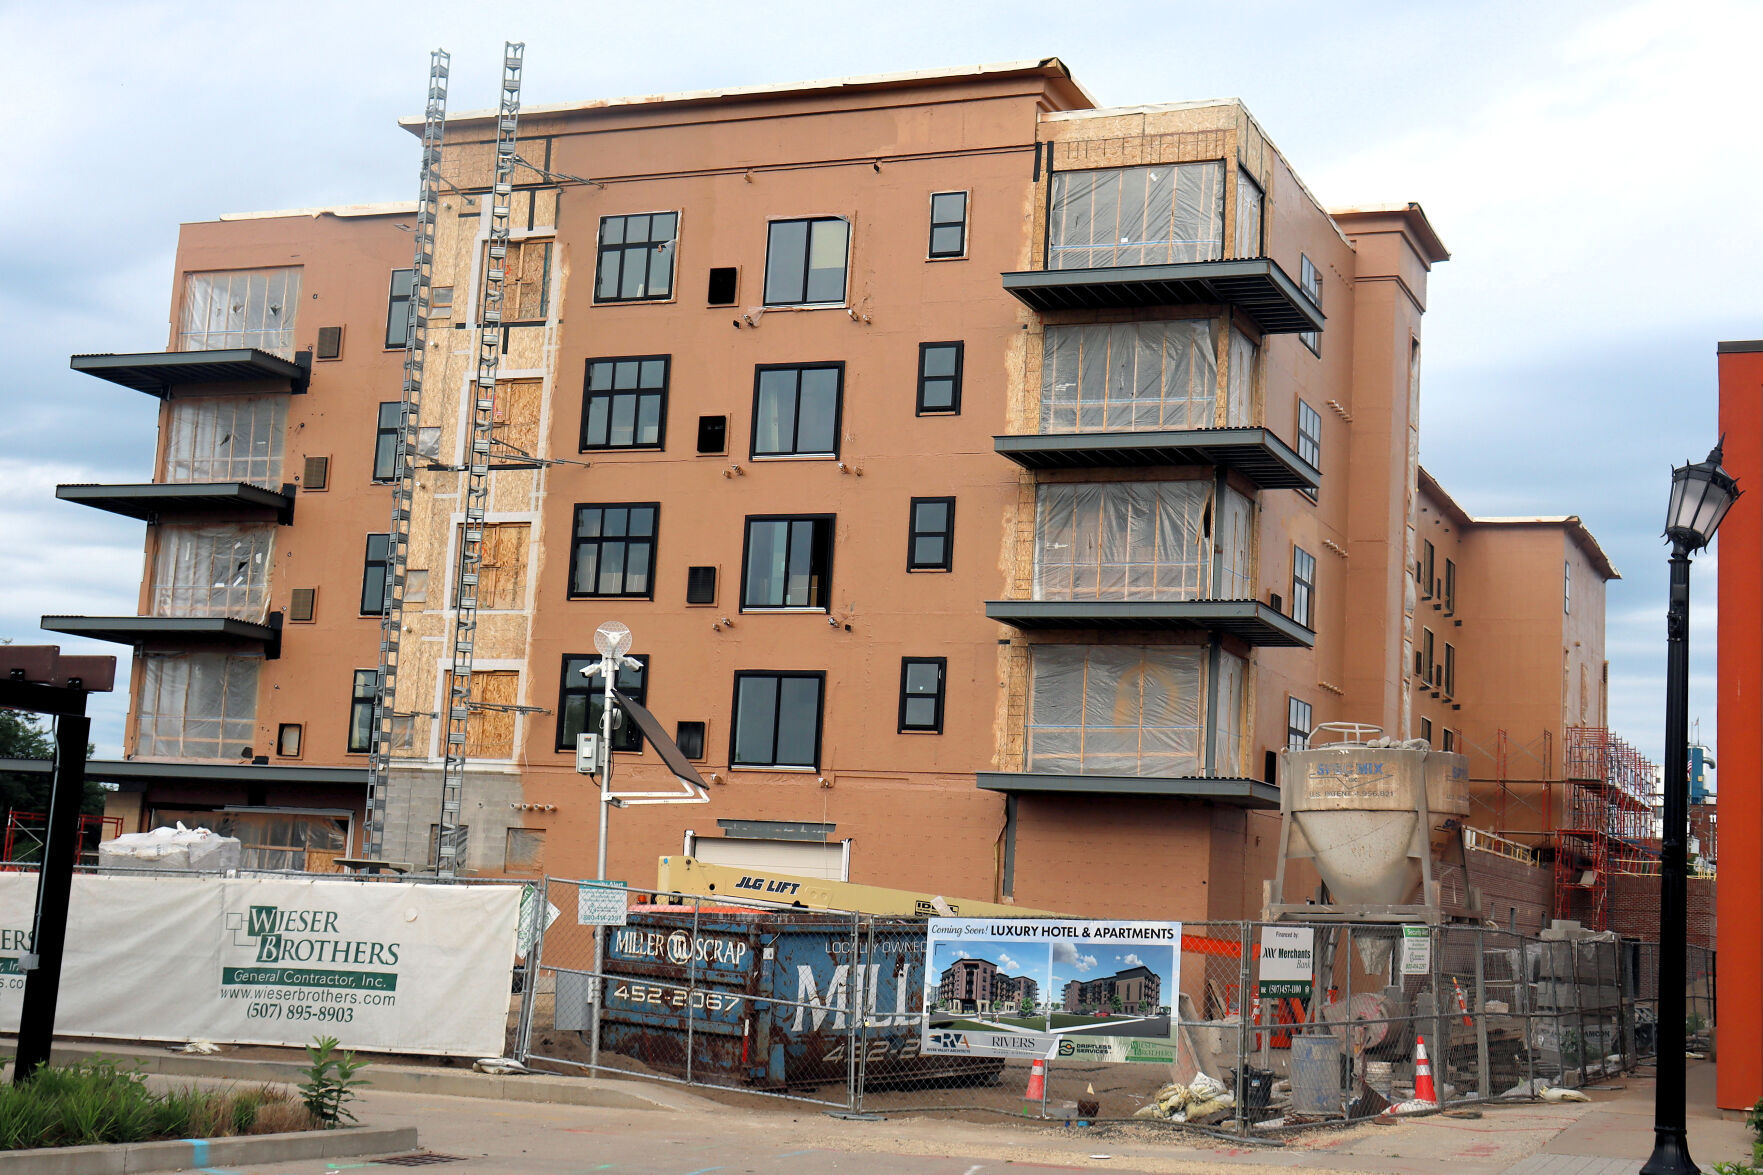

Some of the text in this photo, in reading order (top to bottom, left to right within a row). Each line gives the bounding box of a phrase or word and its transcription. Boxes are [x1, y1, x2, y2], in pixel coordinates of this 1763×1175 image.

[1356, 762, 1384, 775] MIX
[735, 876, 801, 895] JLG LIFT
[917, 902, 957, 913] IDL
[251, 908, 340, 934] WIESER
[931, 924, 1174, 940] Coming Soon! LUXURY HOTEL & APARTMENTS
[1275, 930, 1298, 940] Financed by
[261, 935, 401, 966] BROTHERS
[615, 930, 665, 957] MILLER
[695, 938, 746, 965] SCRAP
[1278, 947, 1311, 959] Merchants
[1296, 959, 1311, 969] Bank
[234, 969, 387, 988] General Contractor, Inc.
[220, 986, 396, 1007] www.wieserbrothers.com
[613, 985, 740, 1013] 452-2067
[246, 1002, 354, 1023] (507) 895-8903
[992, 1036, 1035, 1048] RIVERS
